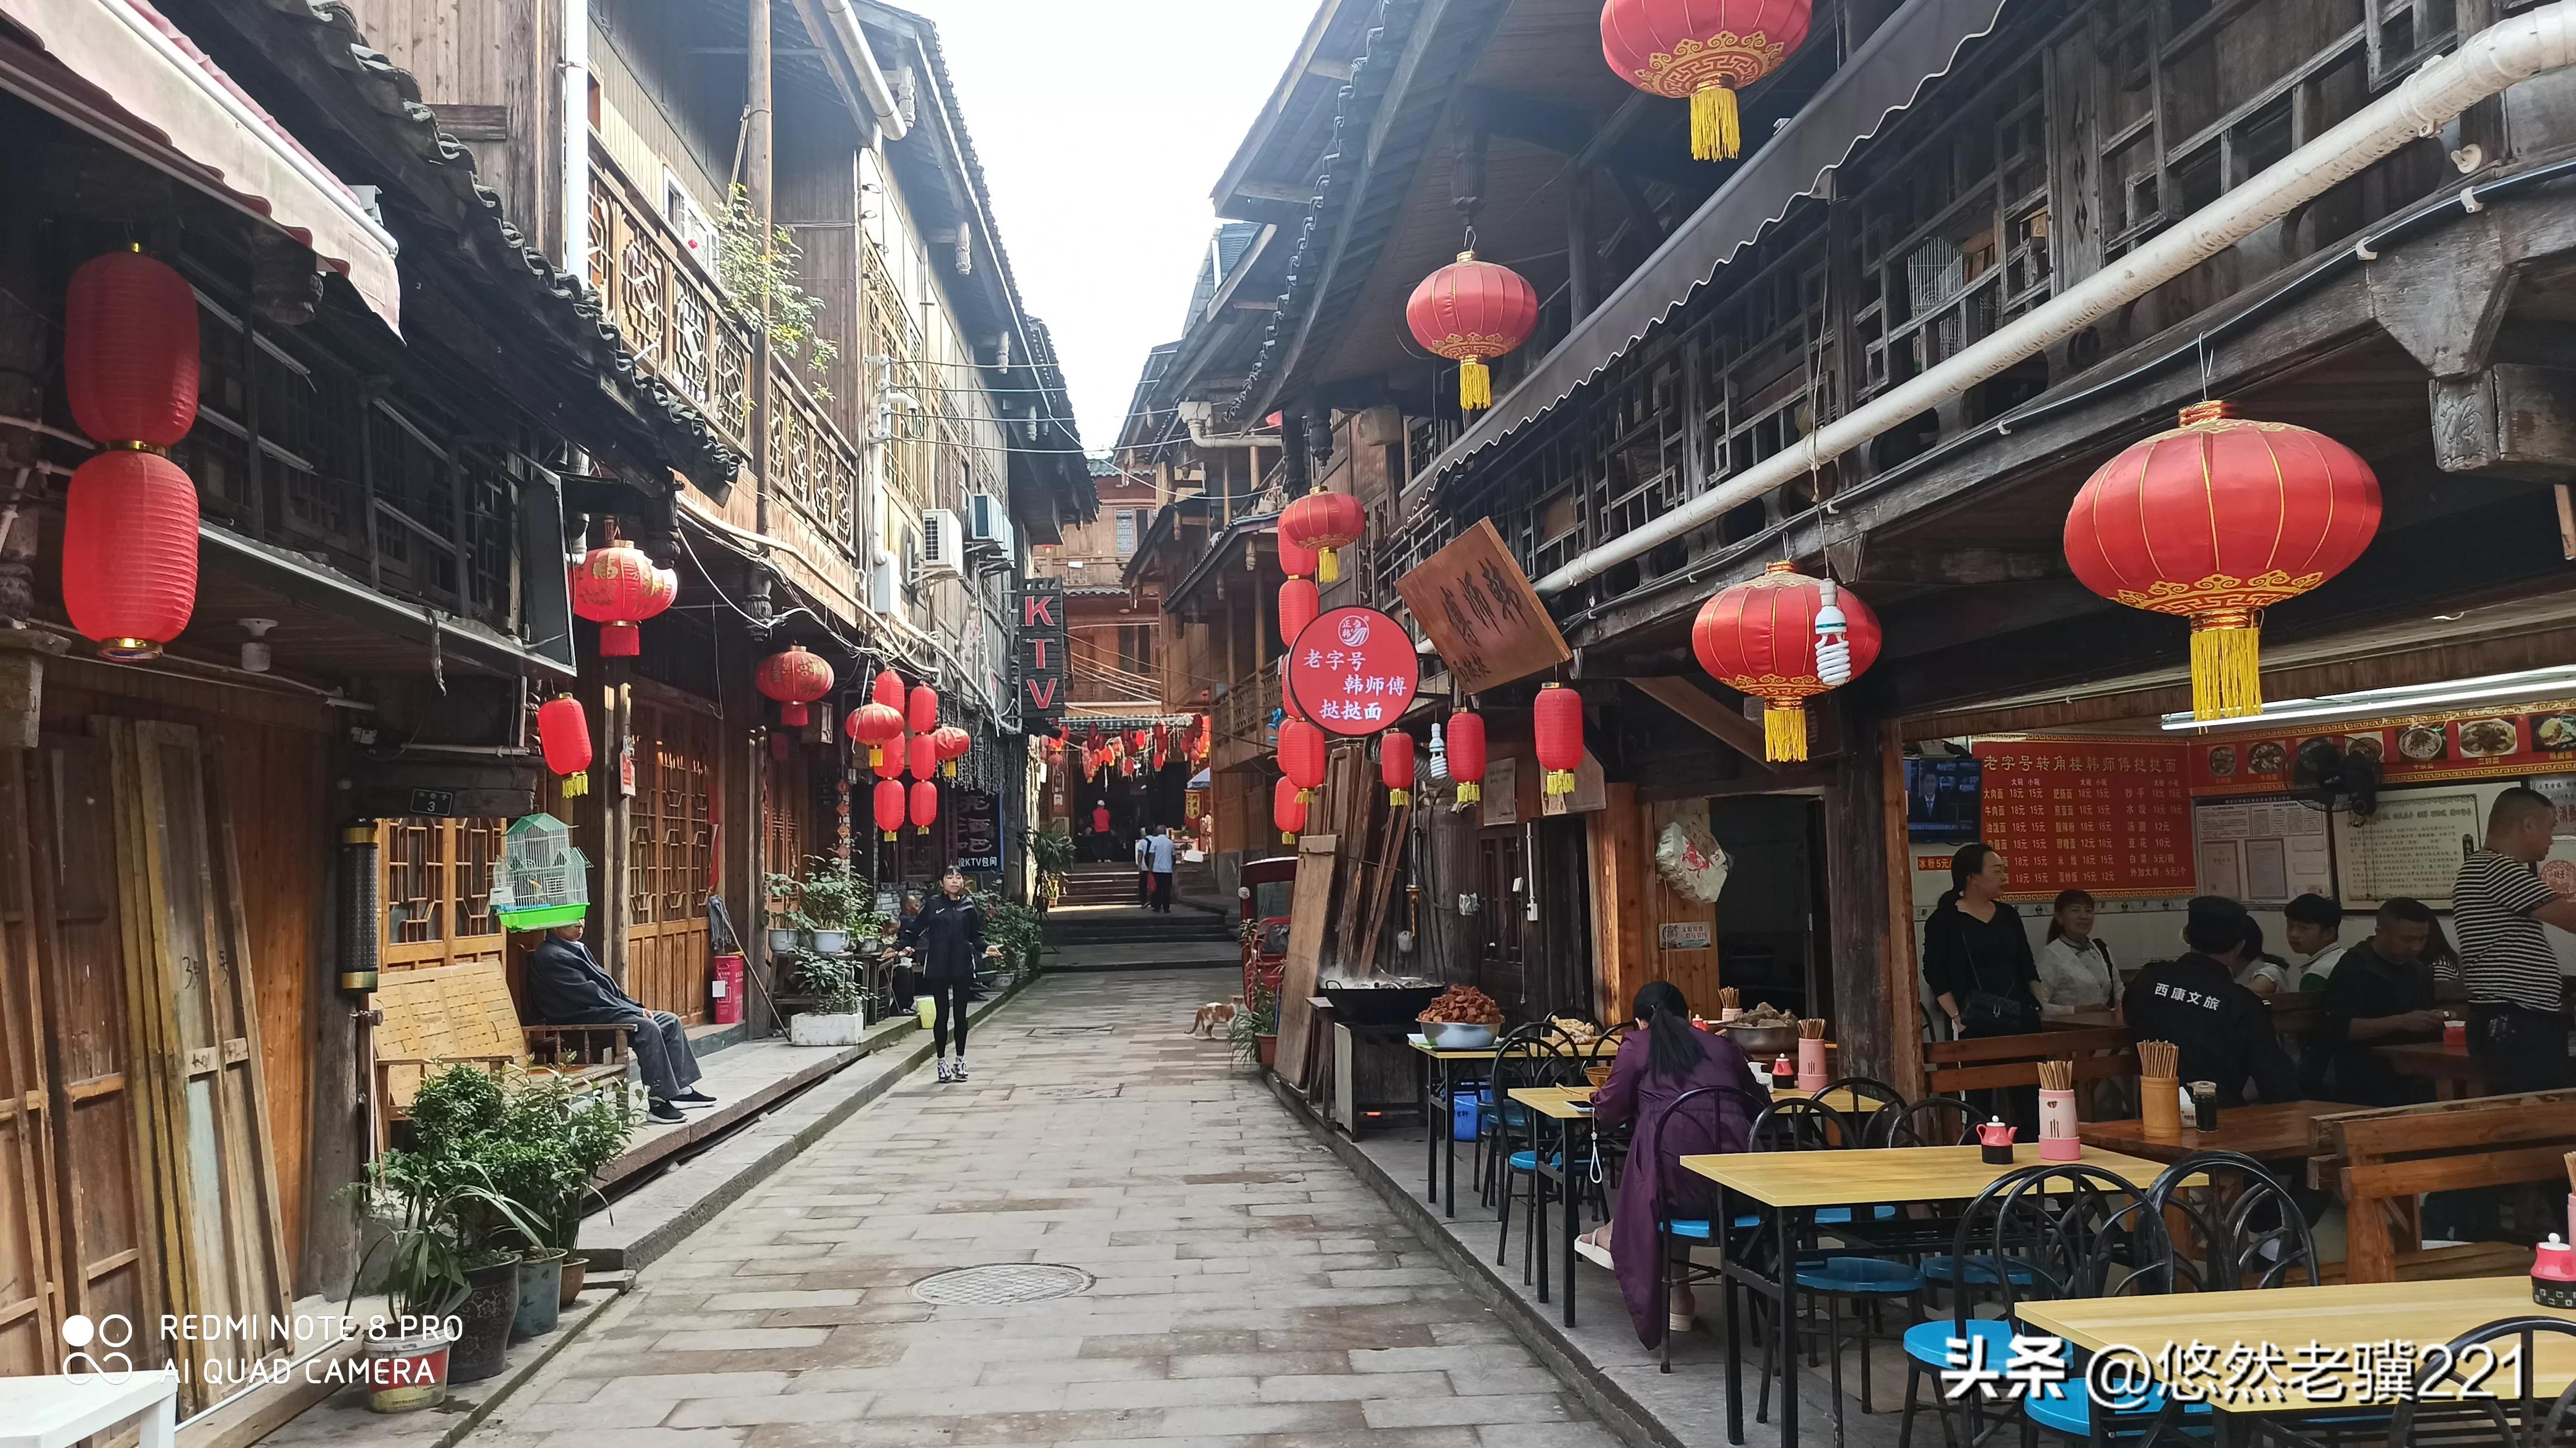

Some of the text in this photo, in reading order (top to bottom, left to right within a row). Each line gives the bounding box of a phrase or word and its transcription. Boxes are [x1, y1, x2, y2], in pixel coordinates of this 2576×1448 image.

[1024, 595, 1058, 710] KTV
[1303, 649, 1366, 672] 老字号
[1343, 674, 1407, 696] 韩师傅
[1319, 699, 1383, 721] 挞挞面
[1983, 755, 2177, 773] 老字号转角楼韩师傅挞挞面
[2011, 778, 2023, 786] 大碗
[2028, 778, 2040, 786] 小碗
[1983, 789, 2043, 800] 大肉面 18元 15元
[2053, 788, 2110, 799] 肥肠面 18元 15元
[2125, 788, 2181, 799] 抄手 18元 15元
[427, 801, 436, 812] 3
[1985, 805, 2044, 816] 牛肉面 18元 15元
[2055, 805, 2110, 816] 煎蛋面 18元 15元
[2126, 804, 2183, 815] 水饺 18元 15元
[2012, 822, 2026, 832] 18元
[2032, 822, 2046, 832] 15元
[2056, 821, 2112, 833] 酸辣粉 18元 15元
[2128, 821, 2170, 833] 汤圆 12元
[2013, 839, 2027, 849] 18元
[2033, 839, 2047, 849] 15元
[2081, 838, 2095, 848] 12元
[2099, 838, 2112, 848] 10元
[2128, 838, 2171, 849] 豆花 10元
[958, 857, 997, 867] 设KTV包间
[2014, 856, 2028, 867] 18元
[2034, 856, 2047, 867] 15元
[2057, 855, 2114, 865] 米线 18元 15元
[2016, 873, 2029, 883] 18元
[2035, 873, 2048, 883] 15元
[2059, 871, 2115, 883] 蛋炒饭 15元 12元
[2155, 982, 2220, 1010] 西康文旅
